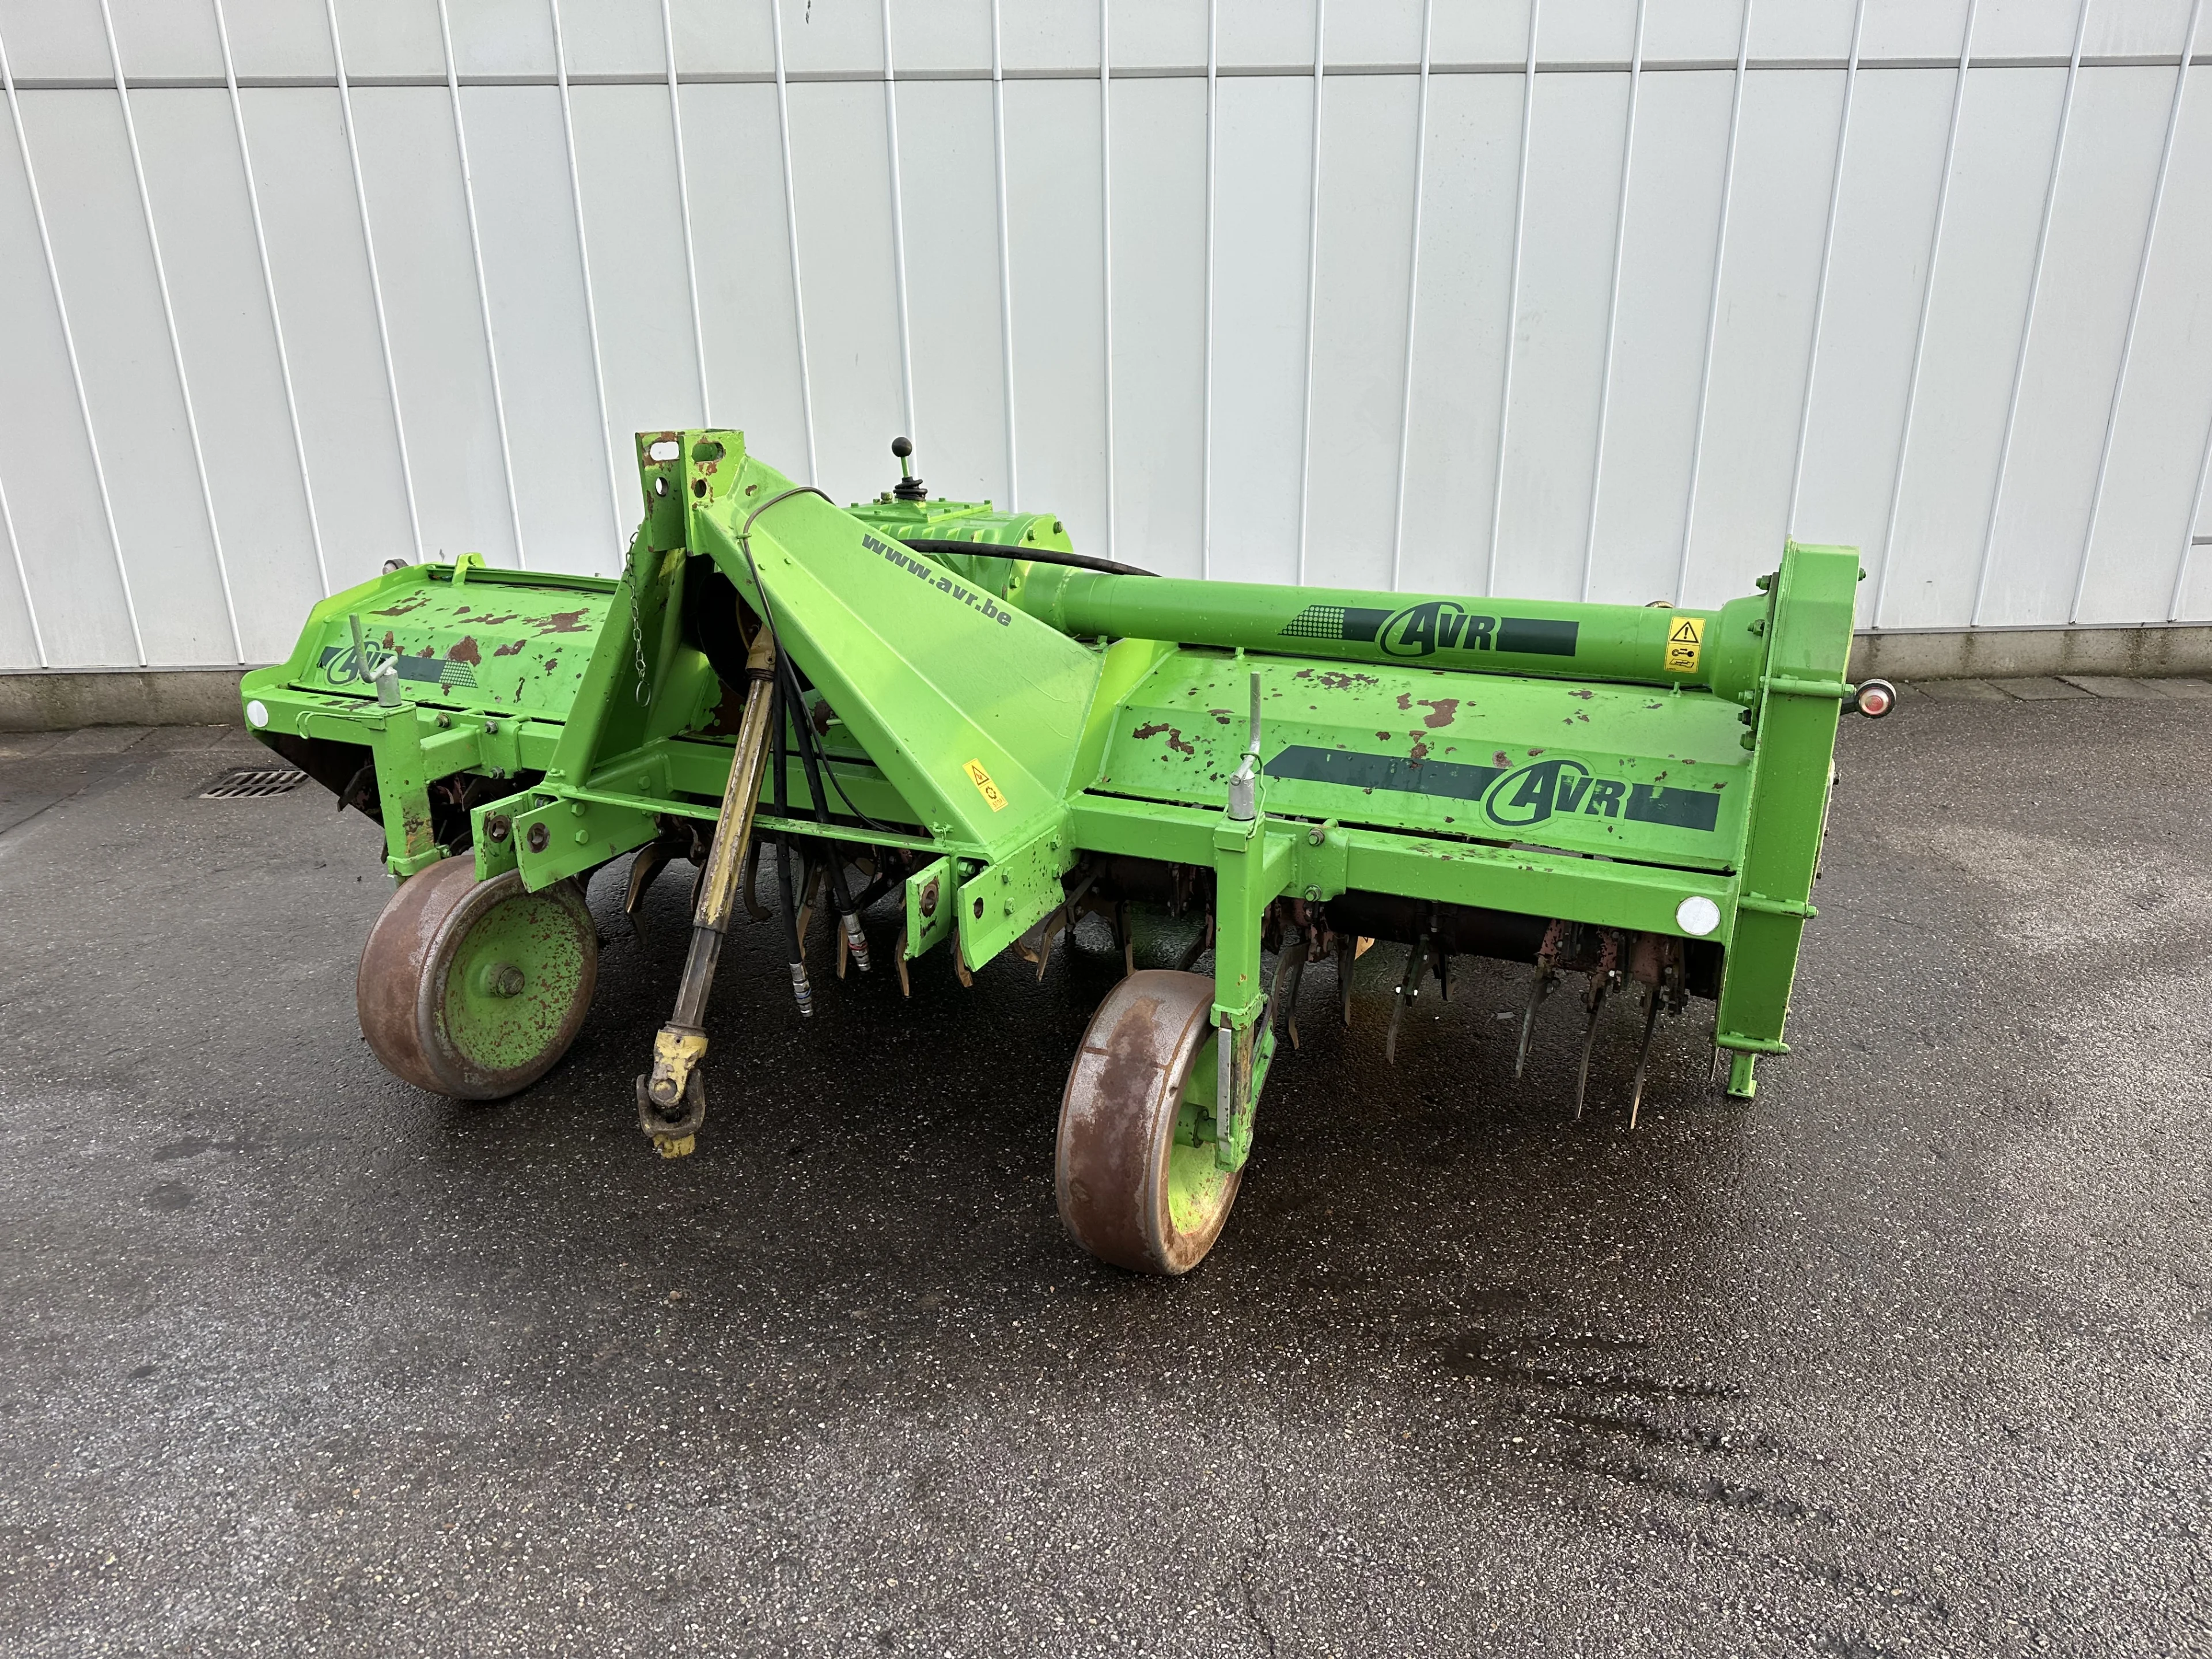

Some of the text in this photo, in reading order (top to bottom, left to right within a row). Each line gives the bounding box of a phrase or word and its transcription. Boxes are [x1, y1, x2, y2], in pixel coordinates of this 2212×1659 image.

[862, 533, 1012, 627] www.avr.be
[1380, 601, 1496, 658] AVR
[1486, 760, 1626, 826] AVR
